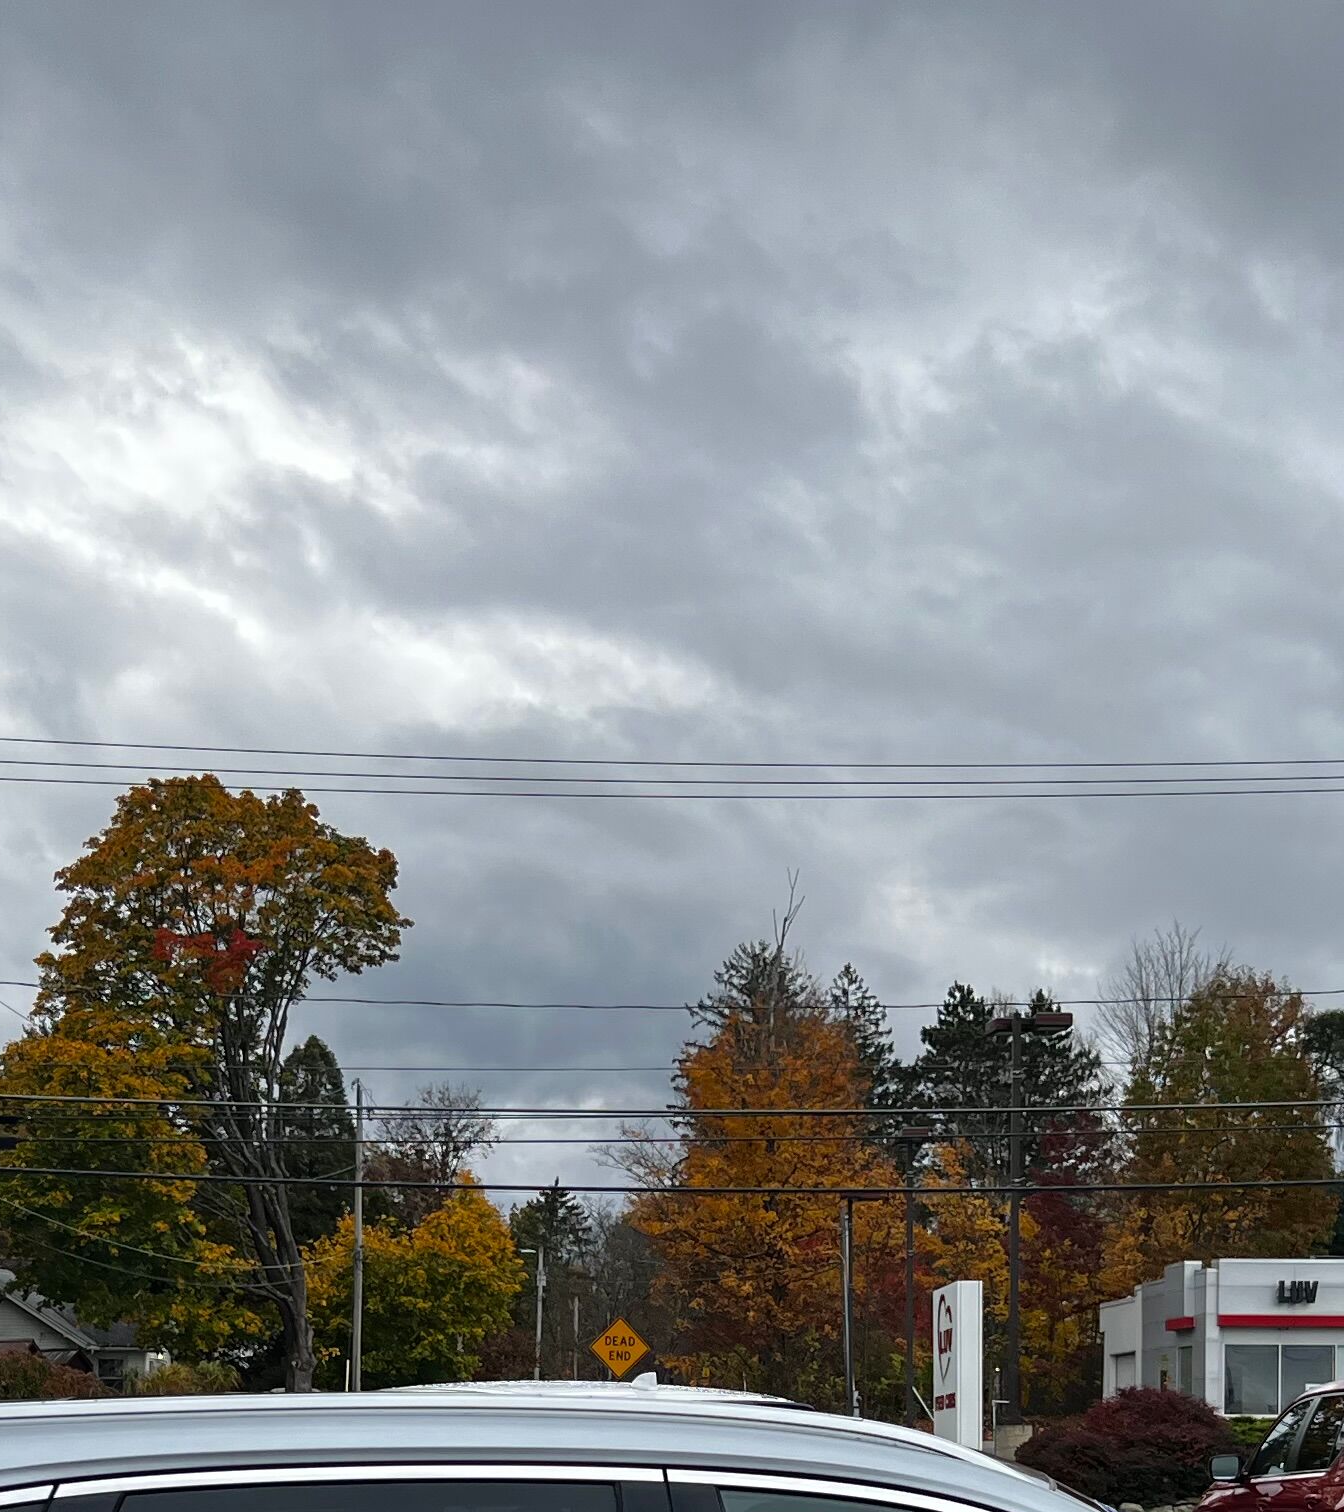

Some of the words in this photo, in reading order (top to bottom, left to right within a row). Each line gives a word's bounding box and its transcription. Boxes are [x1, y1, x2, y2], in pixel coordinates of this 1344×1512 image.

[1277, 1280, 1319, 1304] LUV
[605, 1335, 636, 1346] DEAD
[609, 1350, 631, 1361] END
